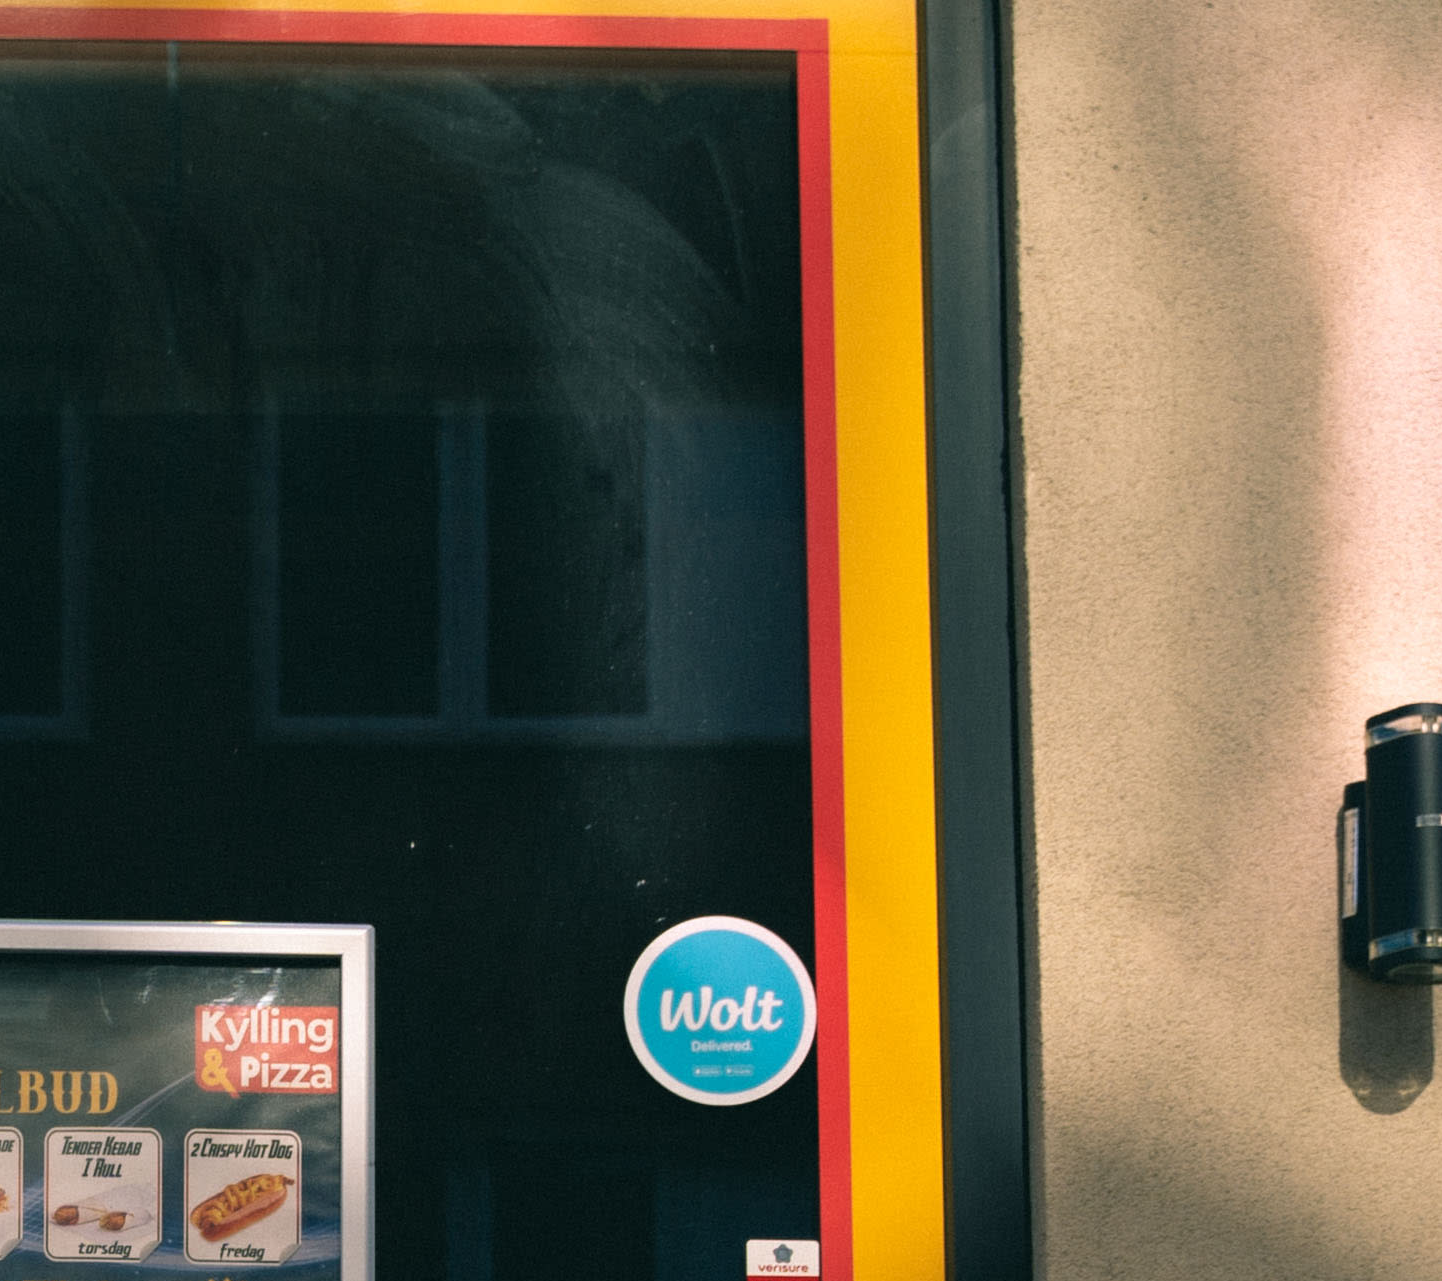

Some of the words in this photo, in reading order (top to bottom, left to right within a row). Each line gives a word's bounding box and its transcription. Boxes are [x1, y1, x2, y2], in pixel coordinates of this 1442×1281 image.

[201, 1007, 333, 1053] Kylling
[660, 985, 784, 1032] Wolt
[200, 1048, 242, 1098] &
[240, 1052, 333, 1089] Pizza
[78, 1240, 133, 1258] torsdag
[219, 1243, 266, 1261] fredag
